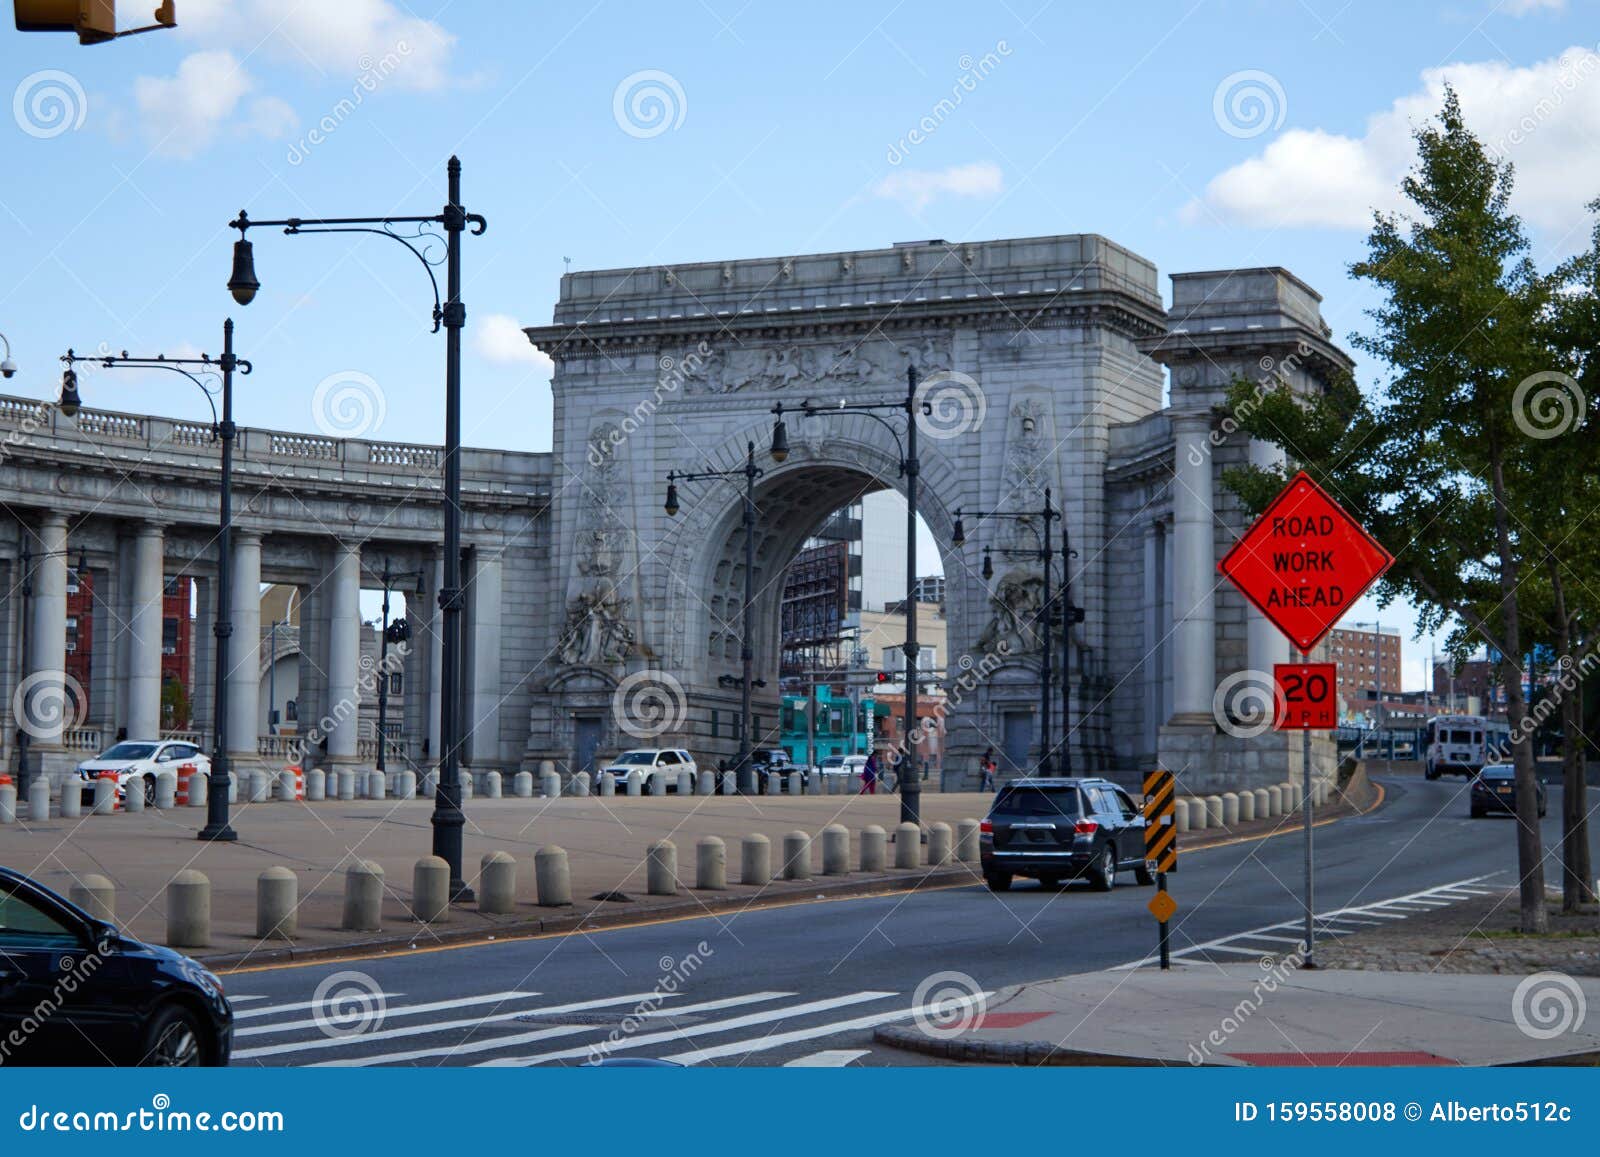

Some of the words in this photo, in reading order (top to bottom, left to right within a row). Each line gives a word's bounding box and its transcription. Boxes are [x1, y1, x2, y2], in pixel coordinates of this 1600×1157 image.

[1272, 516, 1334, 538] ROAD
[1273, 551, 1335, 573] WORK
[1266, 586, 1344, 608] AHEAD
[1282, 673, 1328, 703] 20
